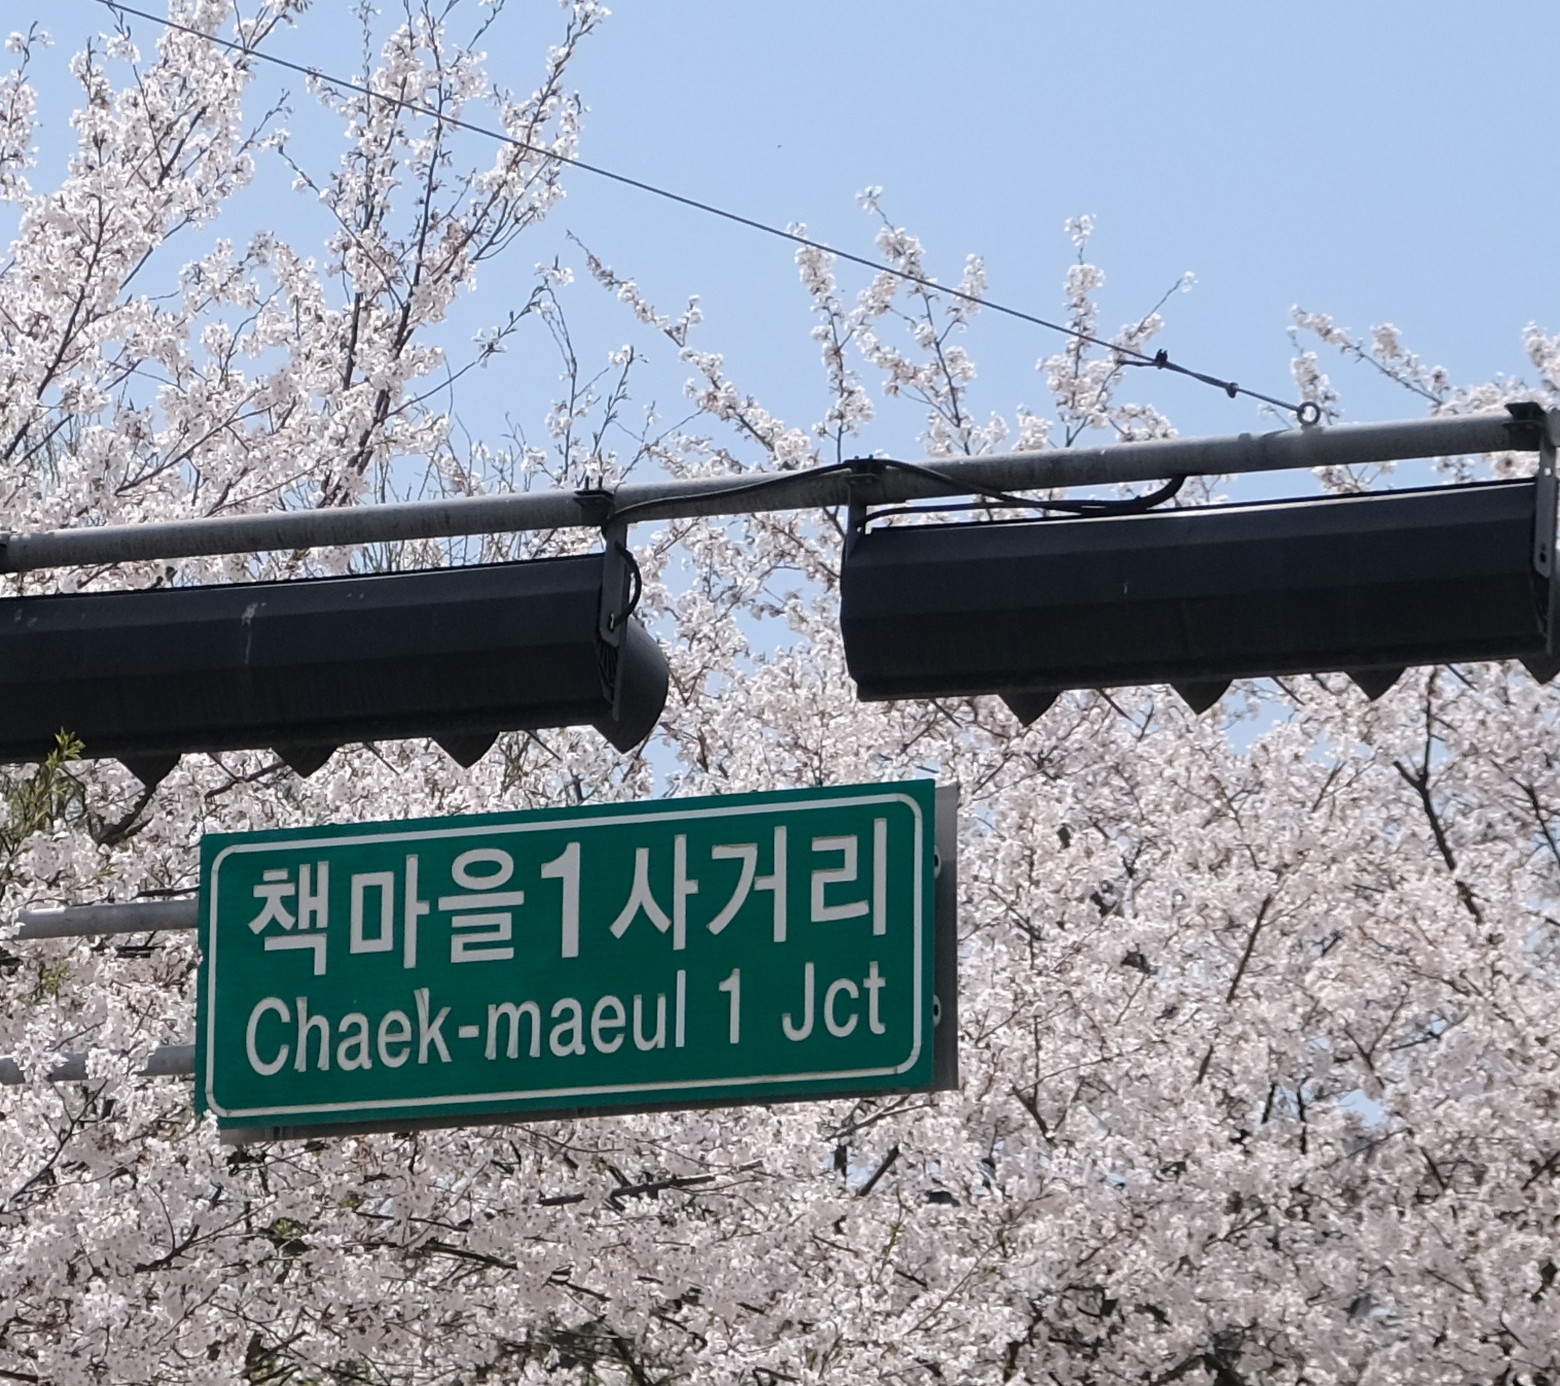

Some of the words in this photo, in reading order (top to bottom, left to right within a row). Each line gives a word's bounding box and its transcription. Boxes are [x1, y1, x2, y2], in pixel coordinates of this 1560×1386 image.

[248, 817, 887, 976] 책마을1사거리
[246, 969, 686, 1076] Chaek-maeul
[718, 967, 742, 1045] 1
[781, 961, 886, 1042] Jct
